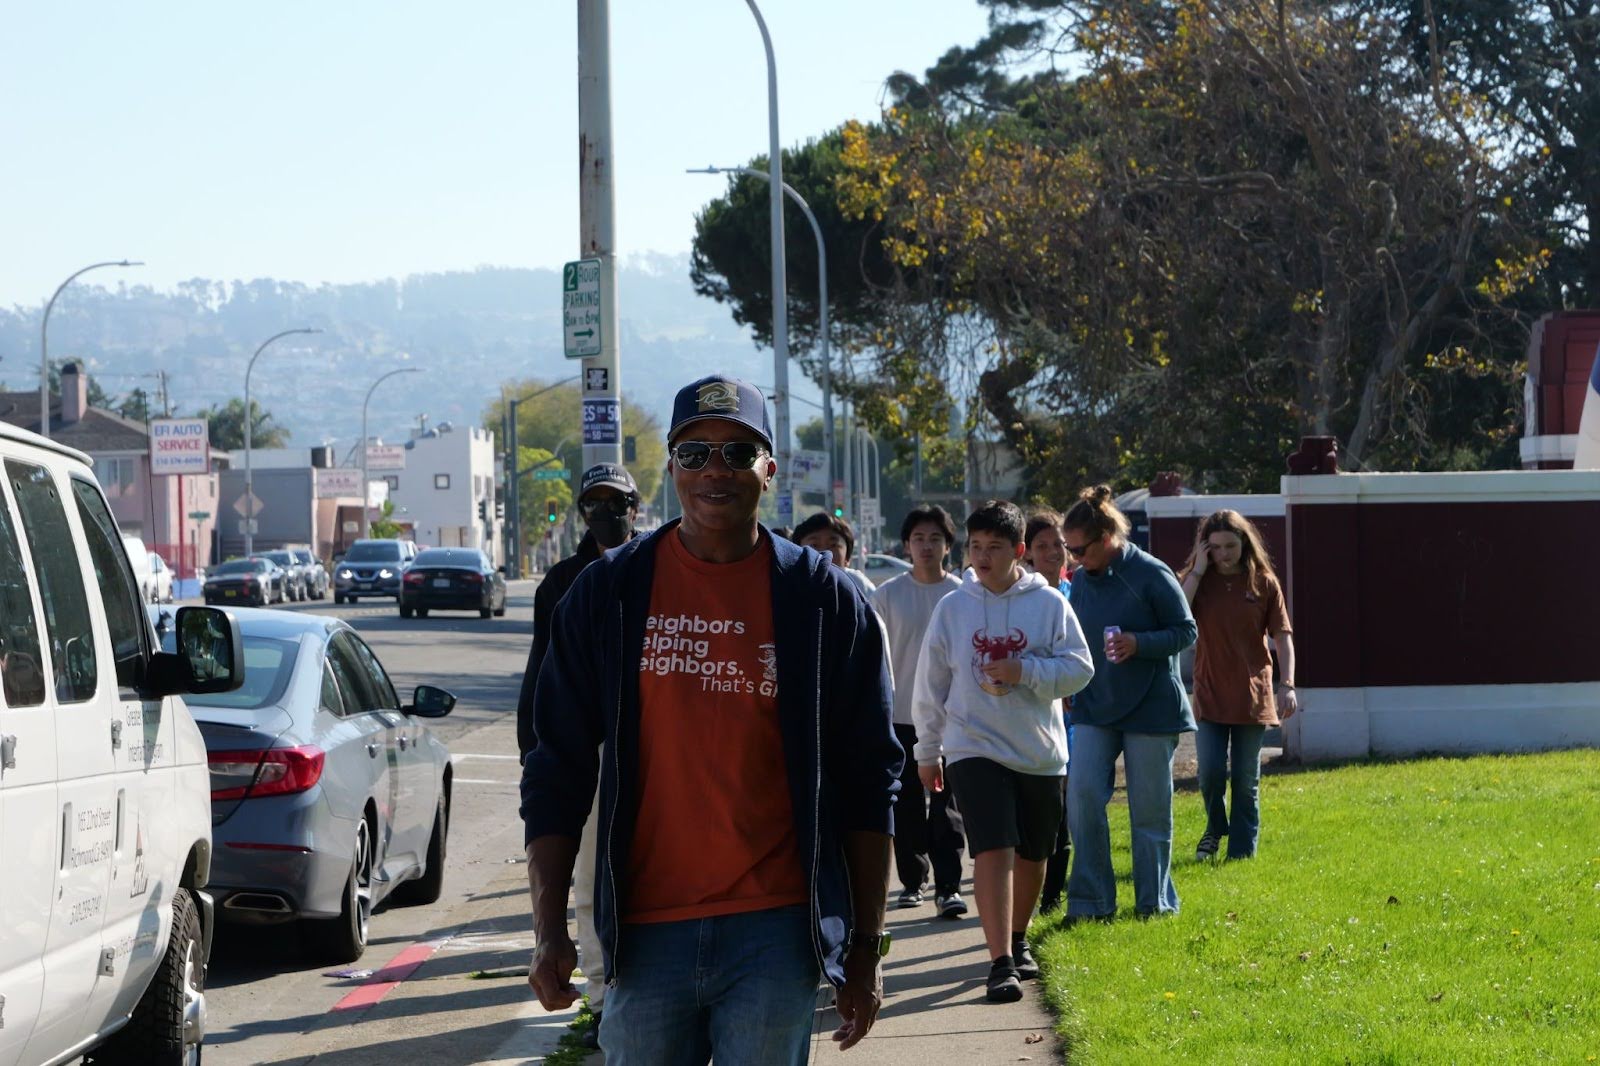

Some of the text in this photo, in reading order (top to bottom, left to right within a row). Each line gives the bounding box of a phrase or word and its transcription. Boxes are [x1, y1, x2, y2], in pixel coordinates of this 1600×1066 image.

[567, 264, 599, 289] 2 HOUR
[564, 291, 599, 310] PARKING
[584, 404, 596, 421] ES
[607, 404, 620, 421] 50
[172, 423, 203, 436] AUTO
[158, 438, 201, 451] SERVICE
[588, 466, 607, 478] Fred
[646, 614, 745, 634] eighbors
[643, 632, 709, 658] elping
[640, 652, 744, 676] eighbors.
[700, 676, 754, 694] That's
